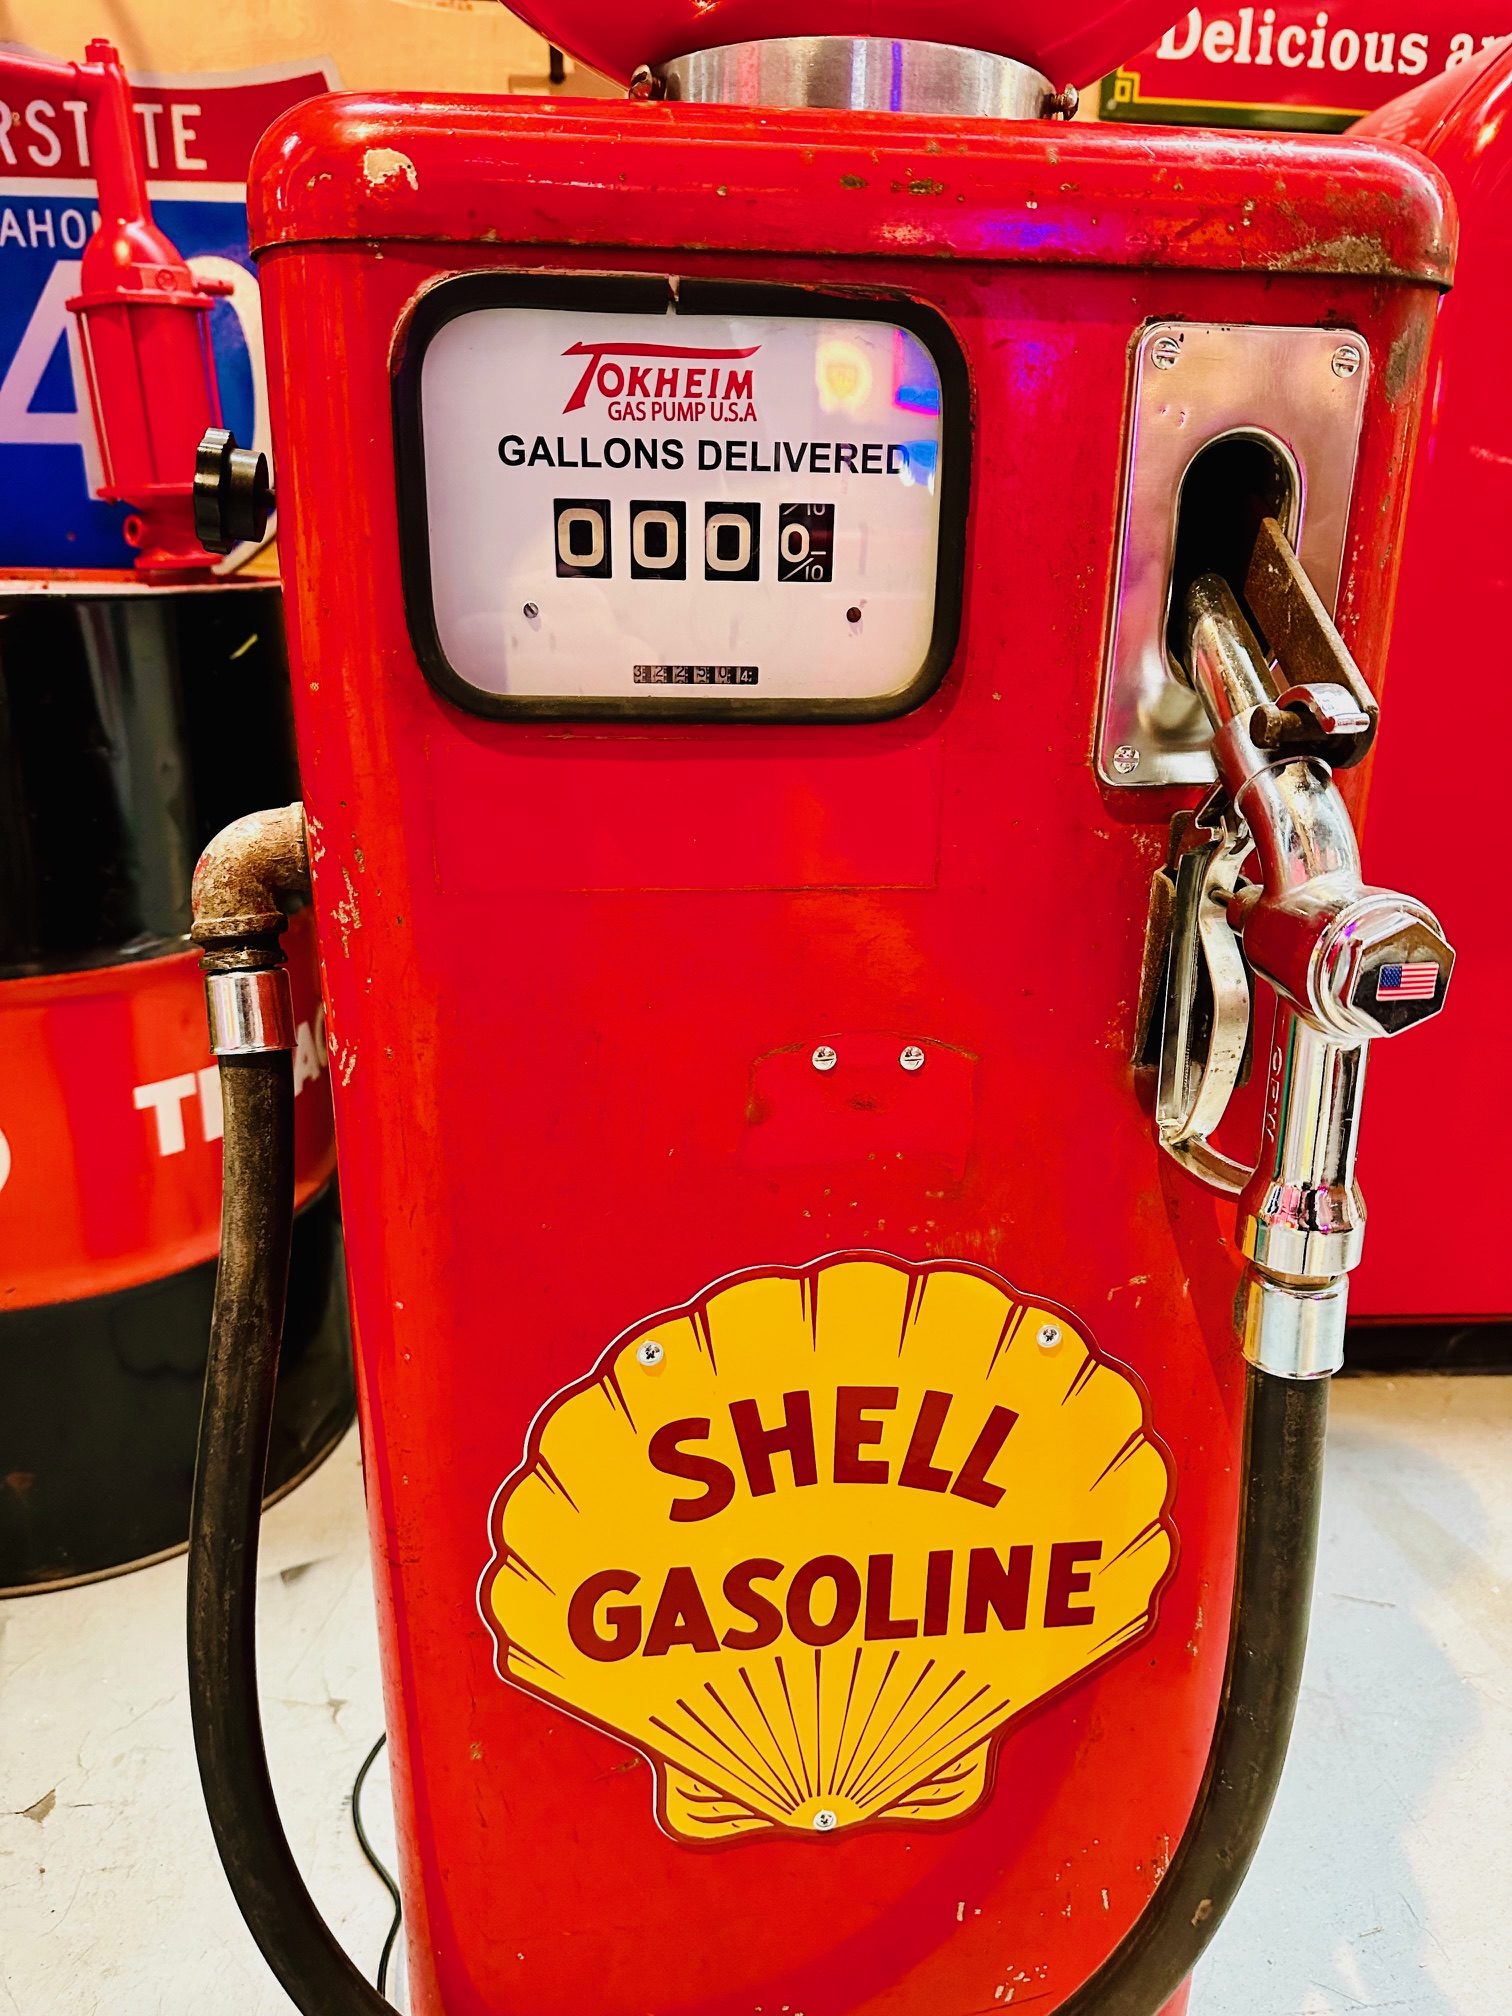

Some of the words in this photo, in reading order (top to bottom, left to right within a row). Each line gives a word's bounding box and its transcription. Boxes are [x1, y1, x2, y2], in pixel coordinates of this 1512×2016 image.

[1156, 6, 1429, 76] Delicious
[0, 99, 208, 171] RSTTE
[0, 208, 102, 249] AHO
[561, 341, 762, 414] TOKHEIM
[608, 401, 646, 422] GAS
[655, 402, 705, 422] PUMP
[498, 435, 685, 470] GALLONS
[698, 439, 910, 475] DELIVERED
[647, 1386, 1020, 1523] SHELL
[567, 1540, 1103, 1663] GASOLINE
